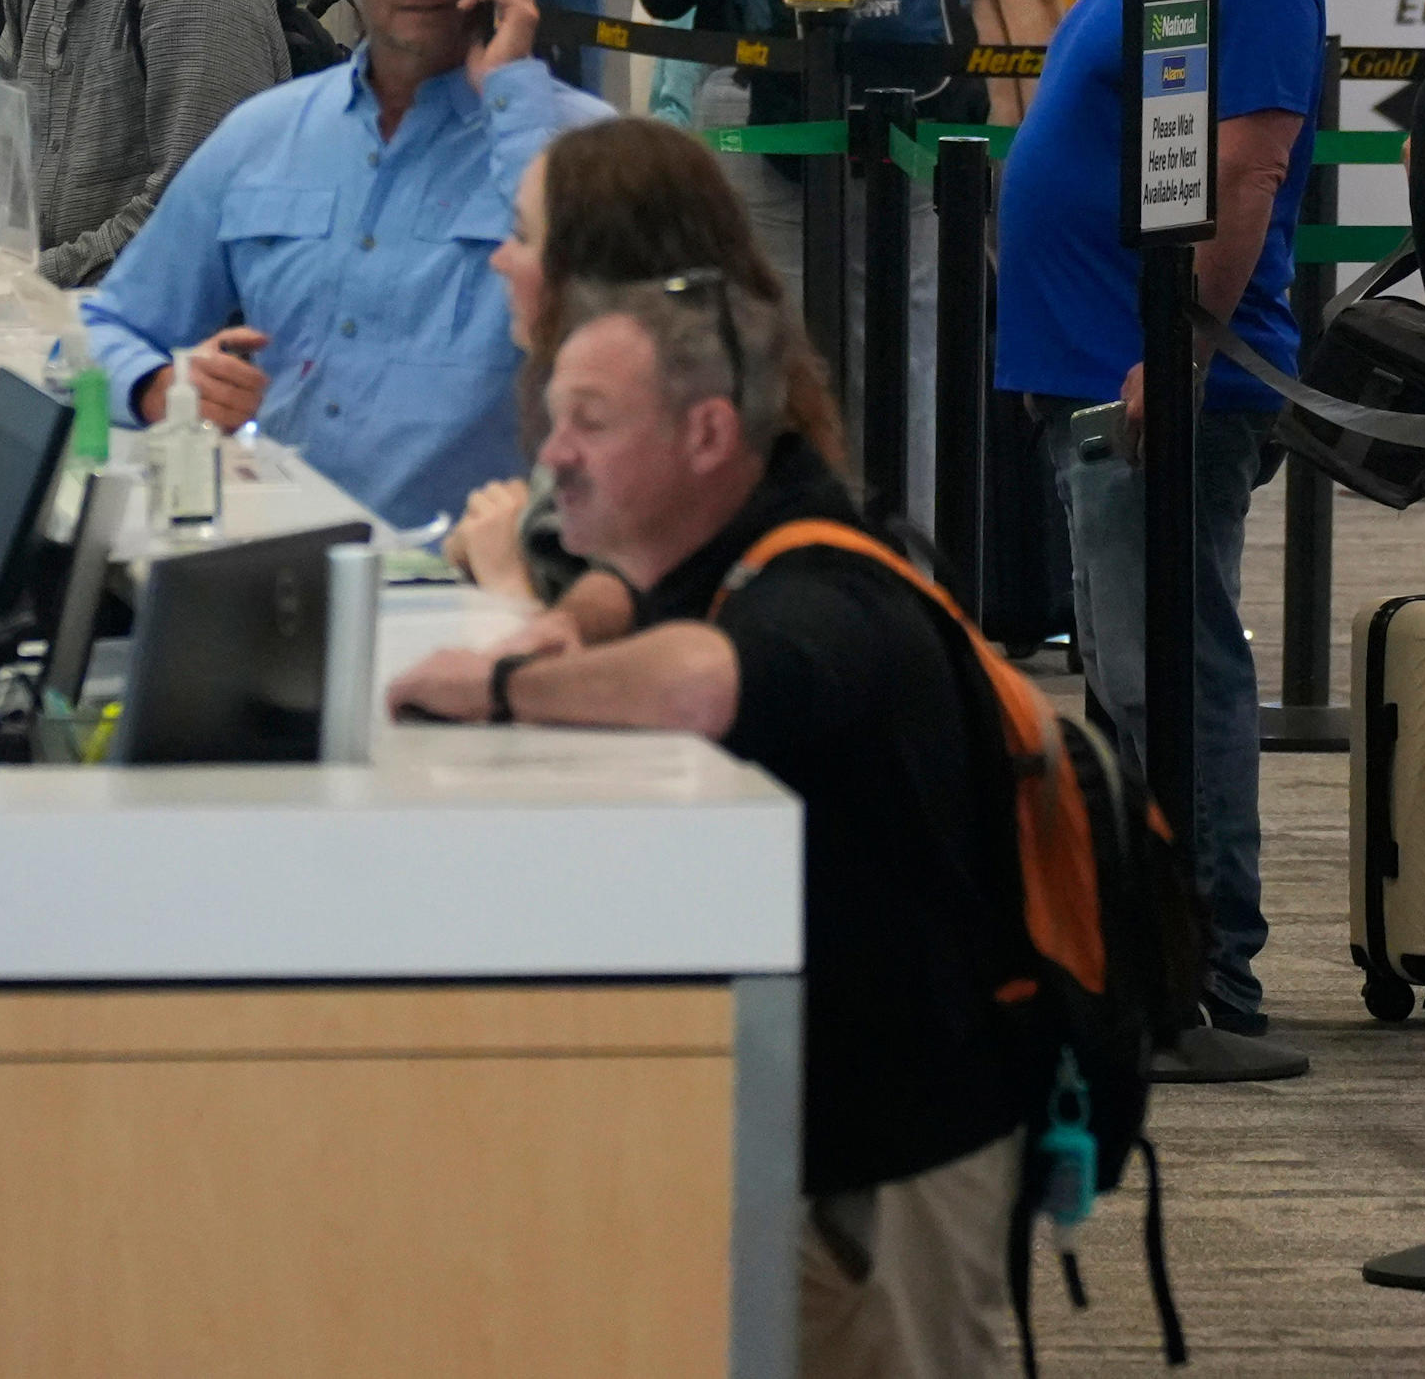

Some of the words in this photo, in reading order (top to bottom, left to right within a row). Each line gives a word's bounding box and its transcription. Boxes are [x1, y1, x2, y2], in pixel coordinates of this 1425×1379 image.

[1161, 12, 1197, 38] National
[967, 47, 1048, 74] Hertz
[1162, 65, 1186, 82] Alamo
[1348, 51, 1420, 79] Gold
[1152, 116, 1176, 140] Please
[1177, 112, 1194, 137] Wait
[1148, 150, 1167, 173] Here
[1167, 146, 1178, 170] for
[1179, 146, 1197, 168] Next
[1142, 179, 1178, 206] Available
[1178, 178, 1202, 207] Agent
